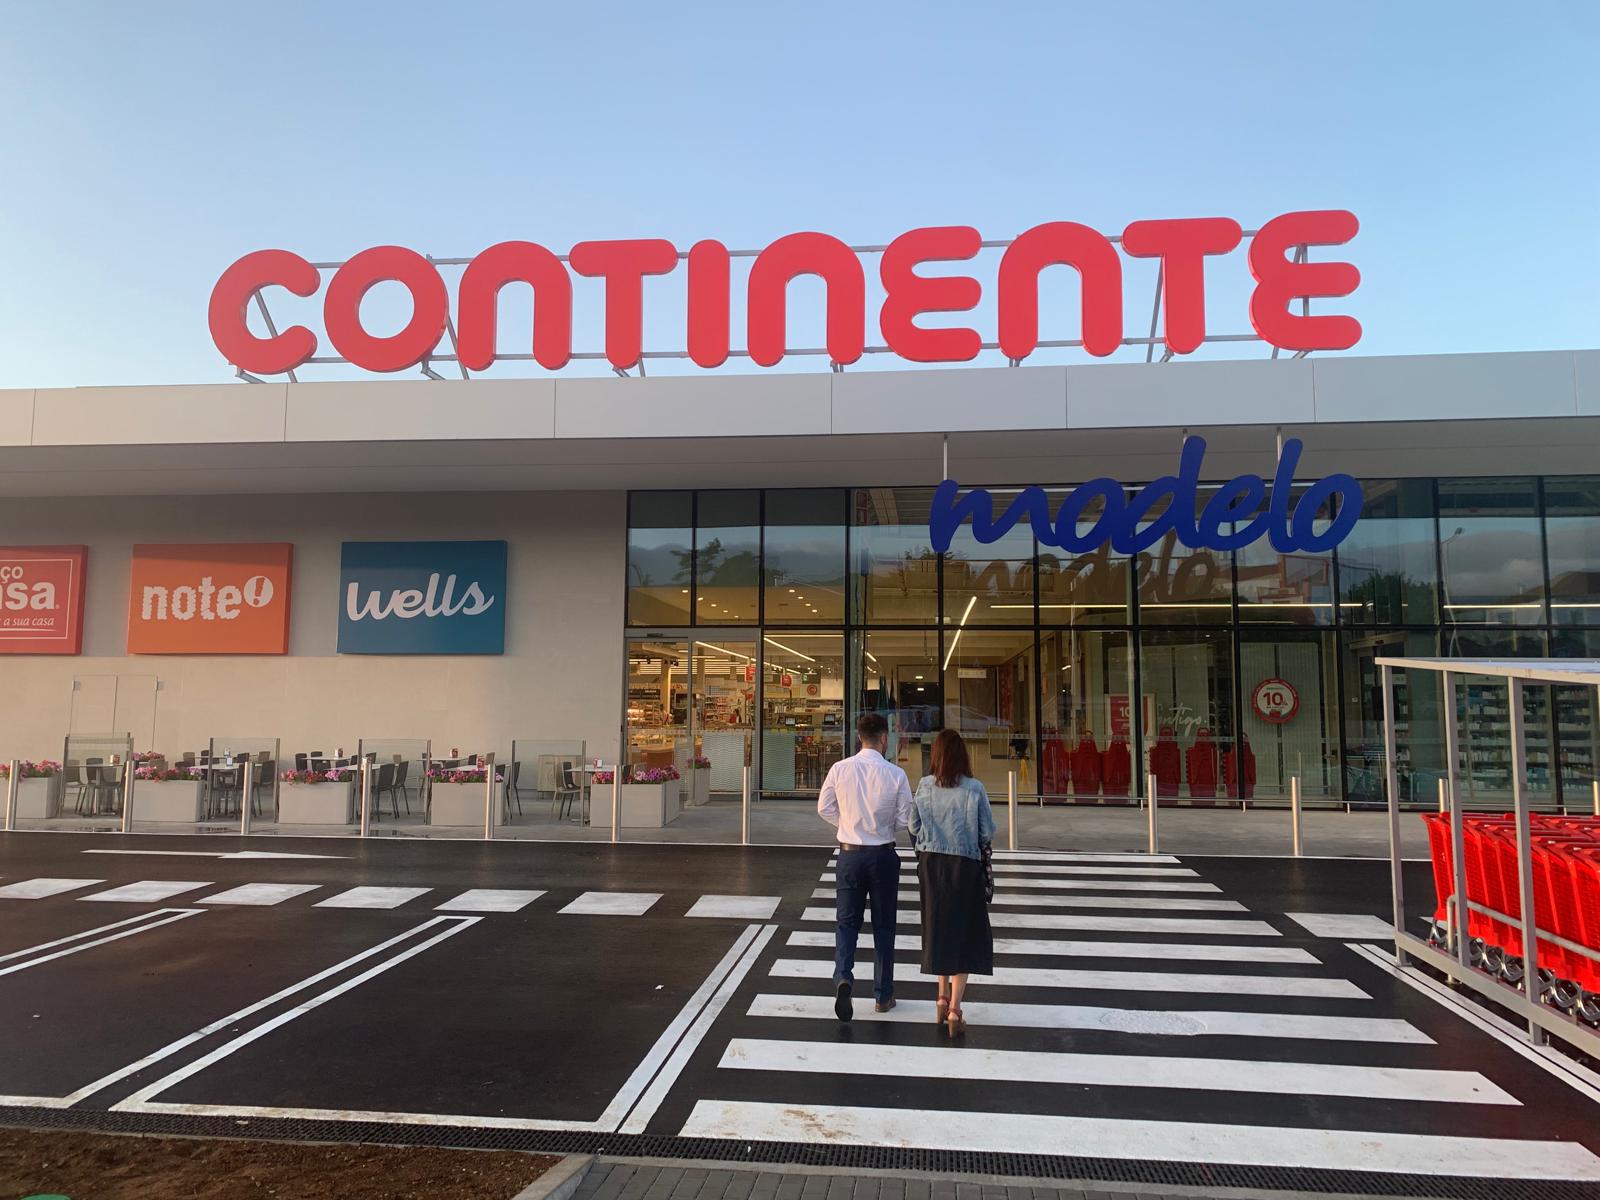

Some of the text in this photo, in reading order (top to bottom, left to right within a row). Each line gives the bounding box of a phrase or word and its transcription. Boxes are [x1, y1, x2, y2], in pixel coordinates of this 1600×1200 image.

[209, 211, 1362, 374] CONTINENTE
[930, 438, 1364, 554] modelo
[0, 581, 56, 611] sa
[346, 573, 494, 621] wells
[12, 617, 30, 626] sua
[32, 617, 55, 626] casa
